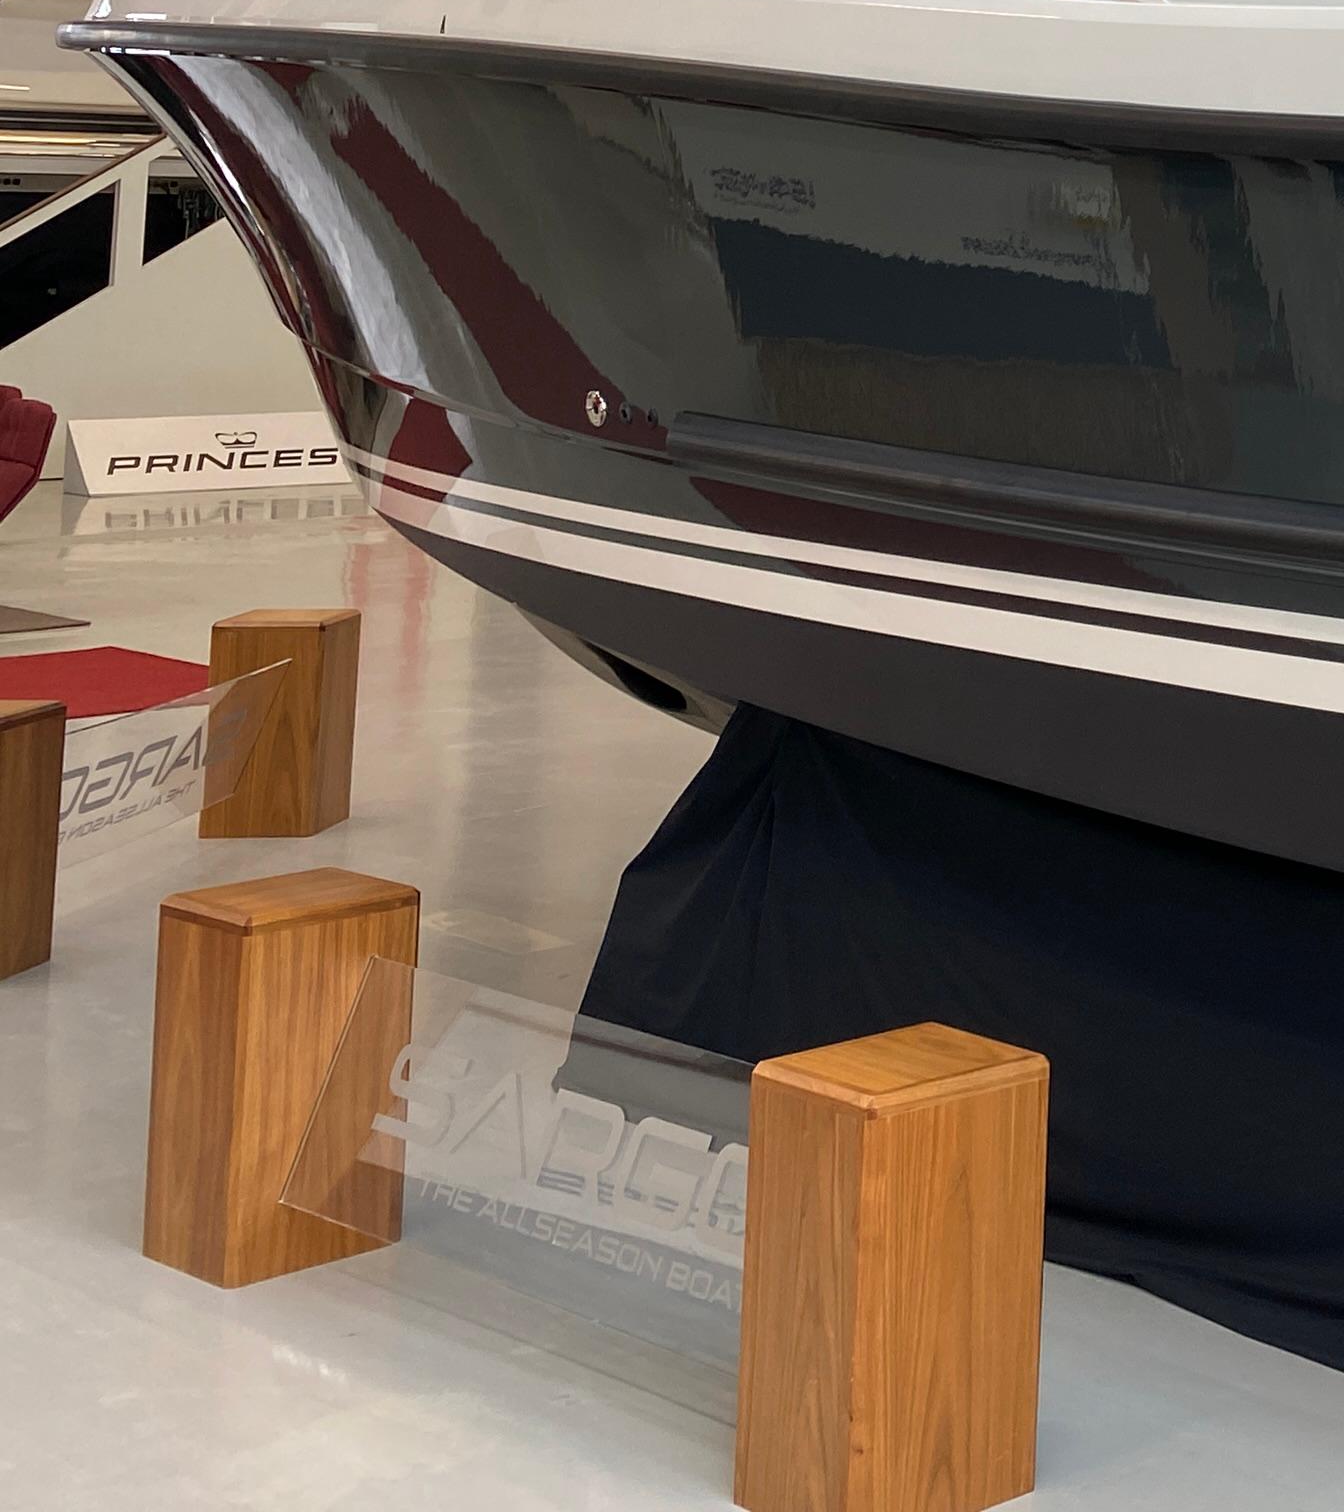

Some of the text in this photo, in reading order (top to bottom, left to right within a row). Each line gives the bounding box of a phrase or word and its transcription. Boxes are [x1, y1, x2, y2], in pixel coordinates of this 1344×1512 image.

[106, 447, 339, 476] PRINCES
[419, 1176, 476, 1214] THE
[477, 1198, 664, 1283] ALLSEASON
